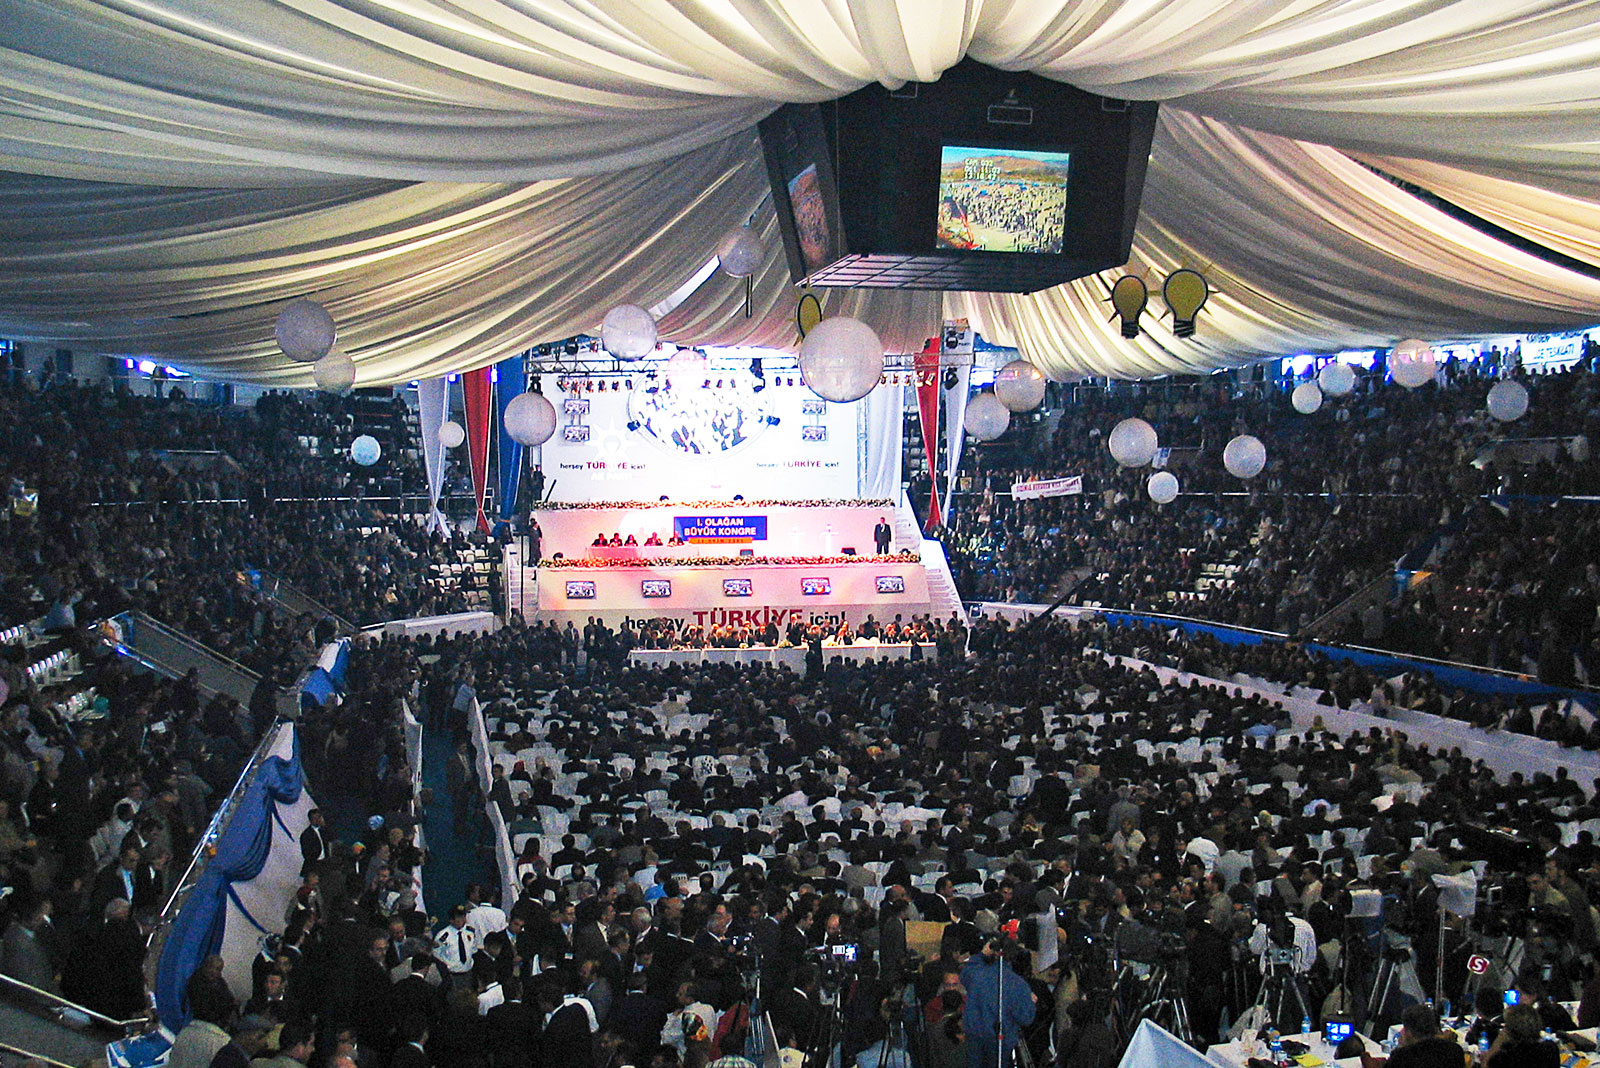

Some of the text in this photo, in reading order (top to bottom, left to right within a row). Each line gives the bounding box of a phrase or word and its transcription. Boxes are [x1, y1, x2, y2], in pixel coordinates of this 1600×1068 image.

[704, 517, 744, 527] OLAĞAN
[684, 527, 757, 536] BÜYÜK KONGRE
[692, 606, 803, 628] TÜRKİYE
[1471, 958, 1485, 971] S
